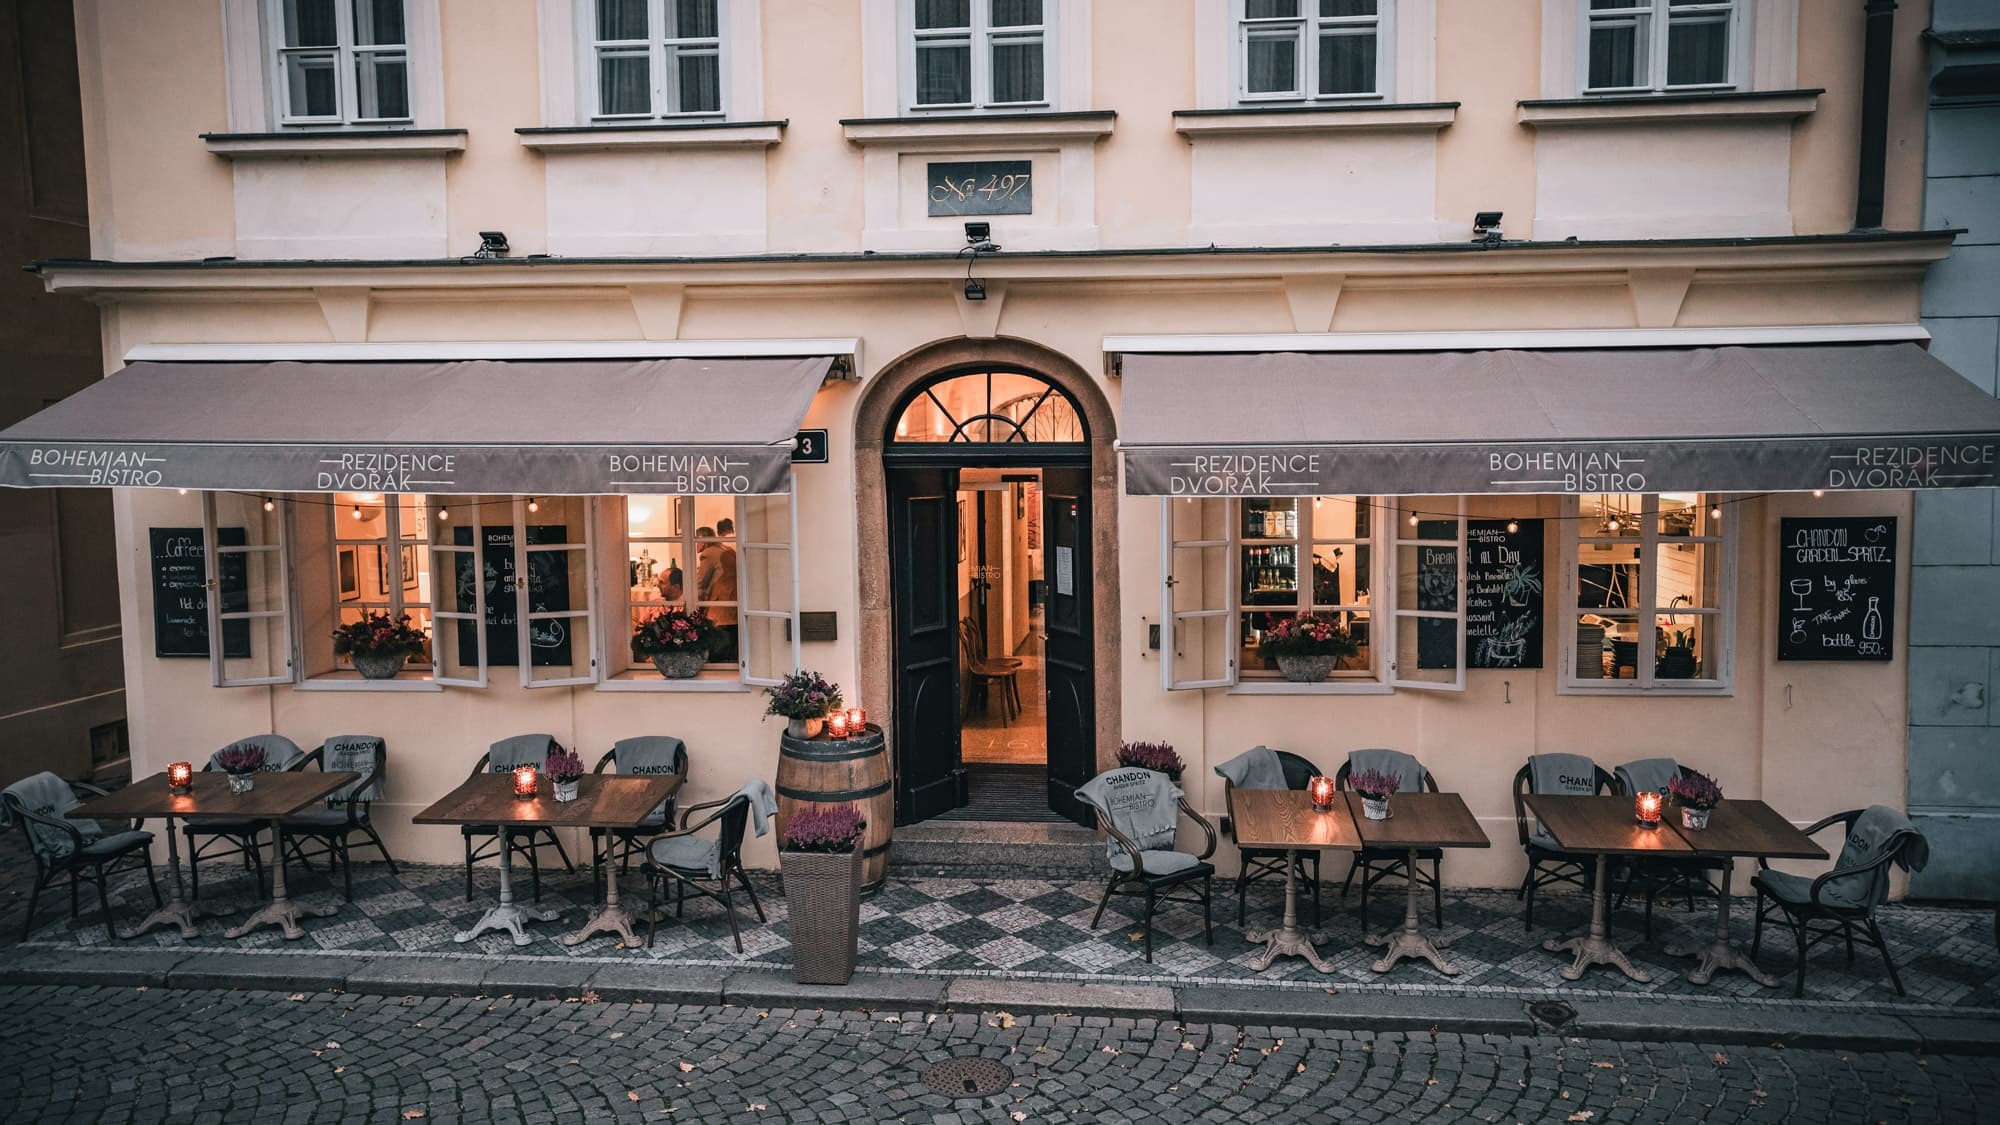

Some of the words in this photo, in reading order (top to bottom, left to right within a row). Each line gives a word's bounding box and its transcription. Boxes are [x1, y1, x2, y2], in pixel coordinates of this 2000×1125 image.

[977, 173, 1031, 201] 497
[802, 438, 812, 455] 3
[1856, 445, 1994, 466] REZIDENCE
[30, 449, 146, 467] BOHEMIAN
[341, 453, 455, 472] REZIDENCE
[610, 455, 727, 472] BOHEMIAN
[1194, 455, 1320, 473] REZIDENCE
[1490, 452, 1620, 471] BOHEMIAN
[90, 468, 162, 486] BISTRO
[317, 468, 411, 490] DVOŘÁK
[677, 475, 750, 492] BISTRO
[1170, 472, 1271, 494] DVOŘÁK
[1565, 473, 1645, 491] BISTRO
[1829, 464, 1939, 487] DVOŘÁK
[1796, 528, 1848, 548] CHANDON
[1824, 574, 1837, 591] by
[334, 741, 377, 751] CHANDON
[632, 765, 673, 774] CHANDON
[1106, 771, 1151, 785] CHANDON
